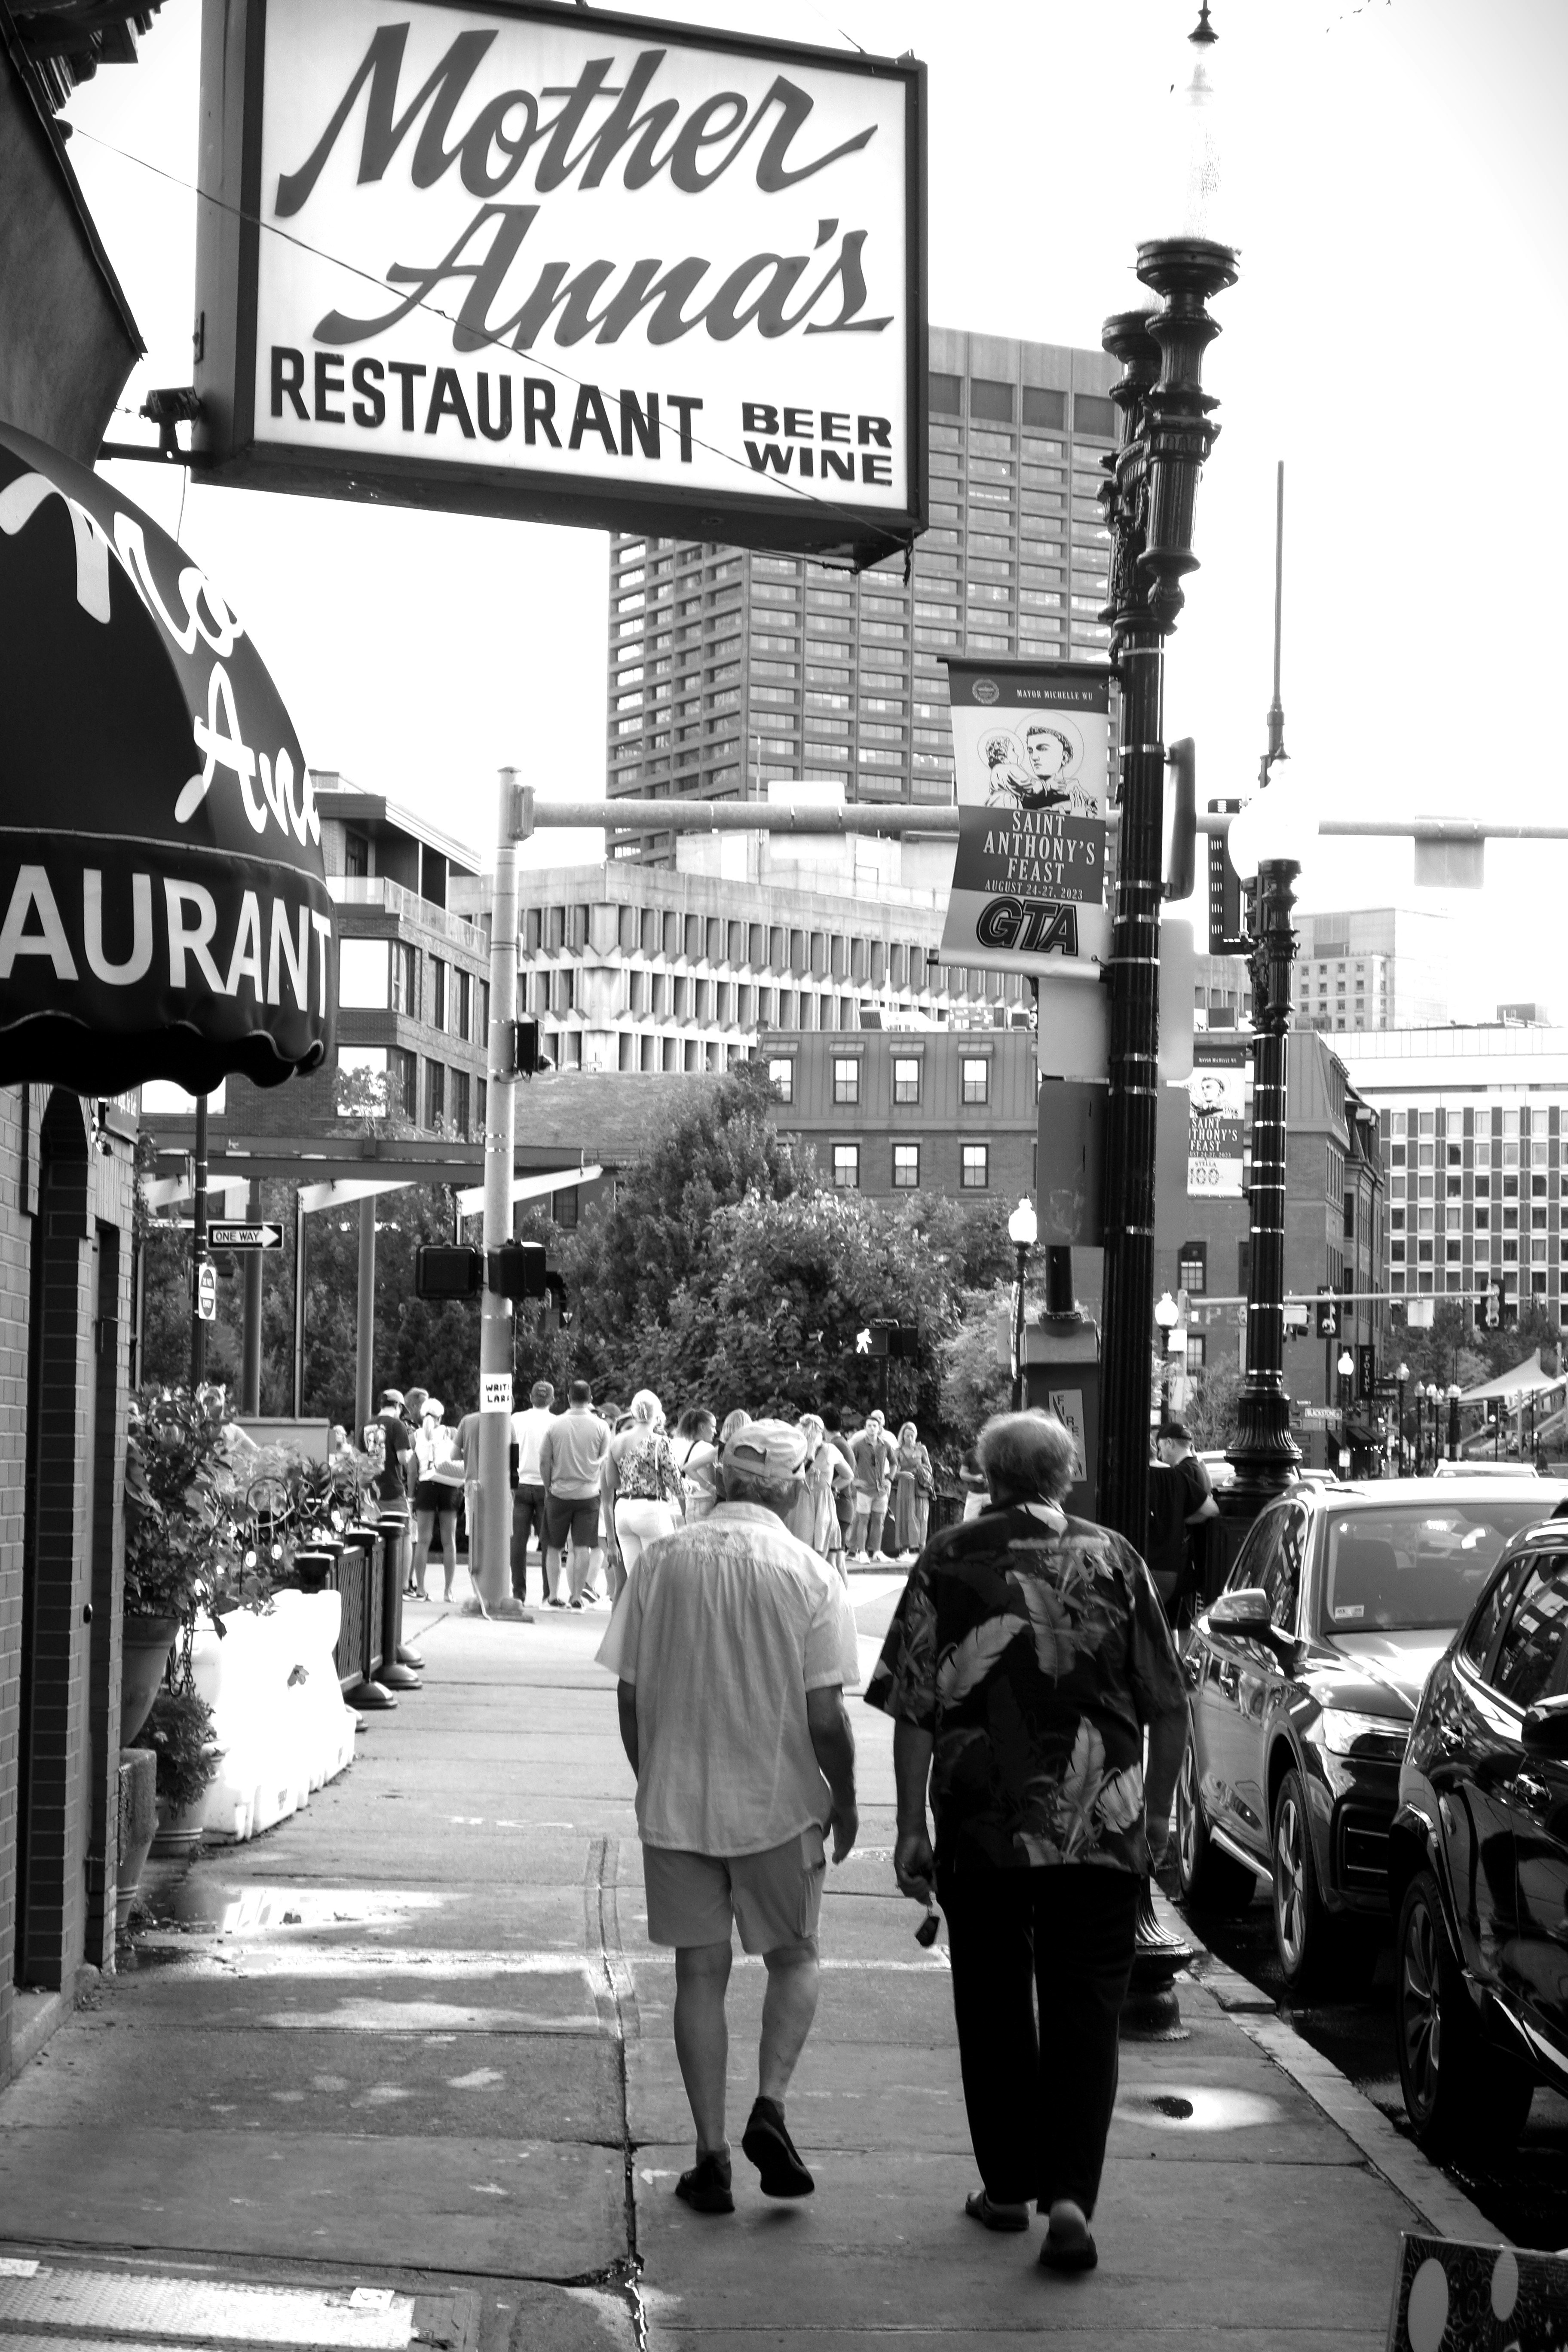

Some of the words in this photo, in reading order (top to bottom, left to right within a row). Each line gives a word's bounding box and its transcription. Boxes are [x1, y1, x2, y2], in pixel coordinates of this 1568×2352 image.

[273, 21, 878, 216] Mother
[312, 202, 895, 352] Anna's
[270, 346, 703, 463] RESTAURANT
[742, 401, 892, 448] BEER
[744, 441, 893, 486] WINE
[1017, 689, 1041, 698] MAYOR
[1044, 690, 1079, 700] MICHELLE
[1082, 692, 1093, 701] WU
[1012, 810, 1065, 837] SAINT
[983, 830, 1095, 866] ANTHONY'S
[1007, 857, 1064, 885] FEAST
[984, 879, 1023, 894] AUGUST
[1026, 883, 1057, 898] 24-27,
[1060, 887, 1083, 901] 2023
[976, 896, 1078, 956] GTA
[1189, 1128, 1237, 1142] THONY'S
[1192, 1118, 1221, 1129] SAINT
[1191, 1140, 1221, 1152] FEAST
[216, 1231, 236, 1242] ONE
[239, 1231, 259, 1241] WAY
[1057, 1394, 1079, 1436] FIRE
